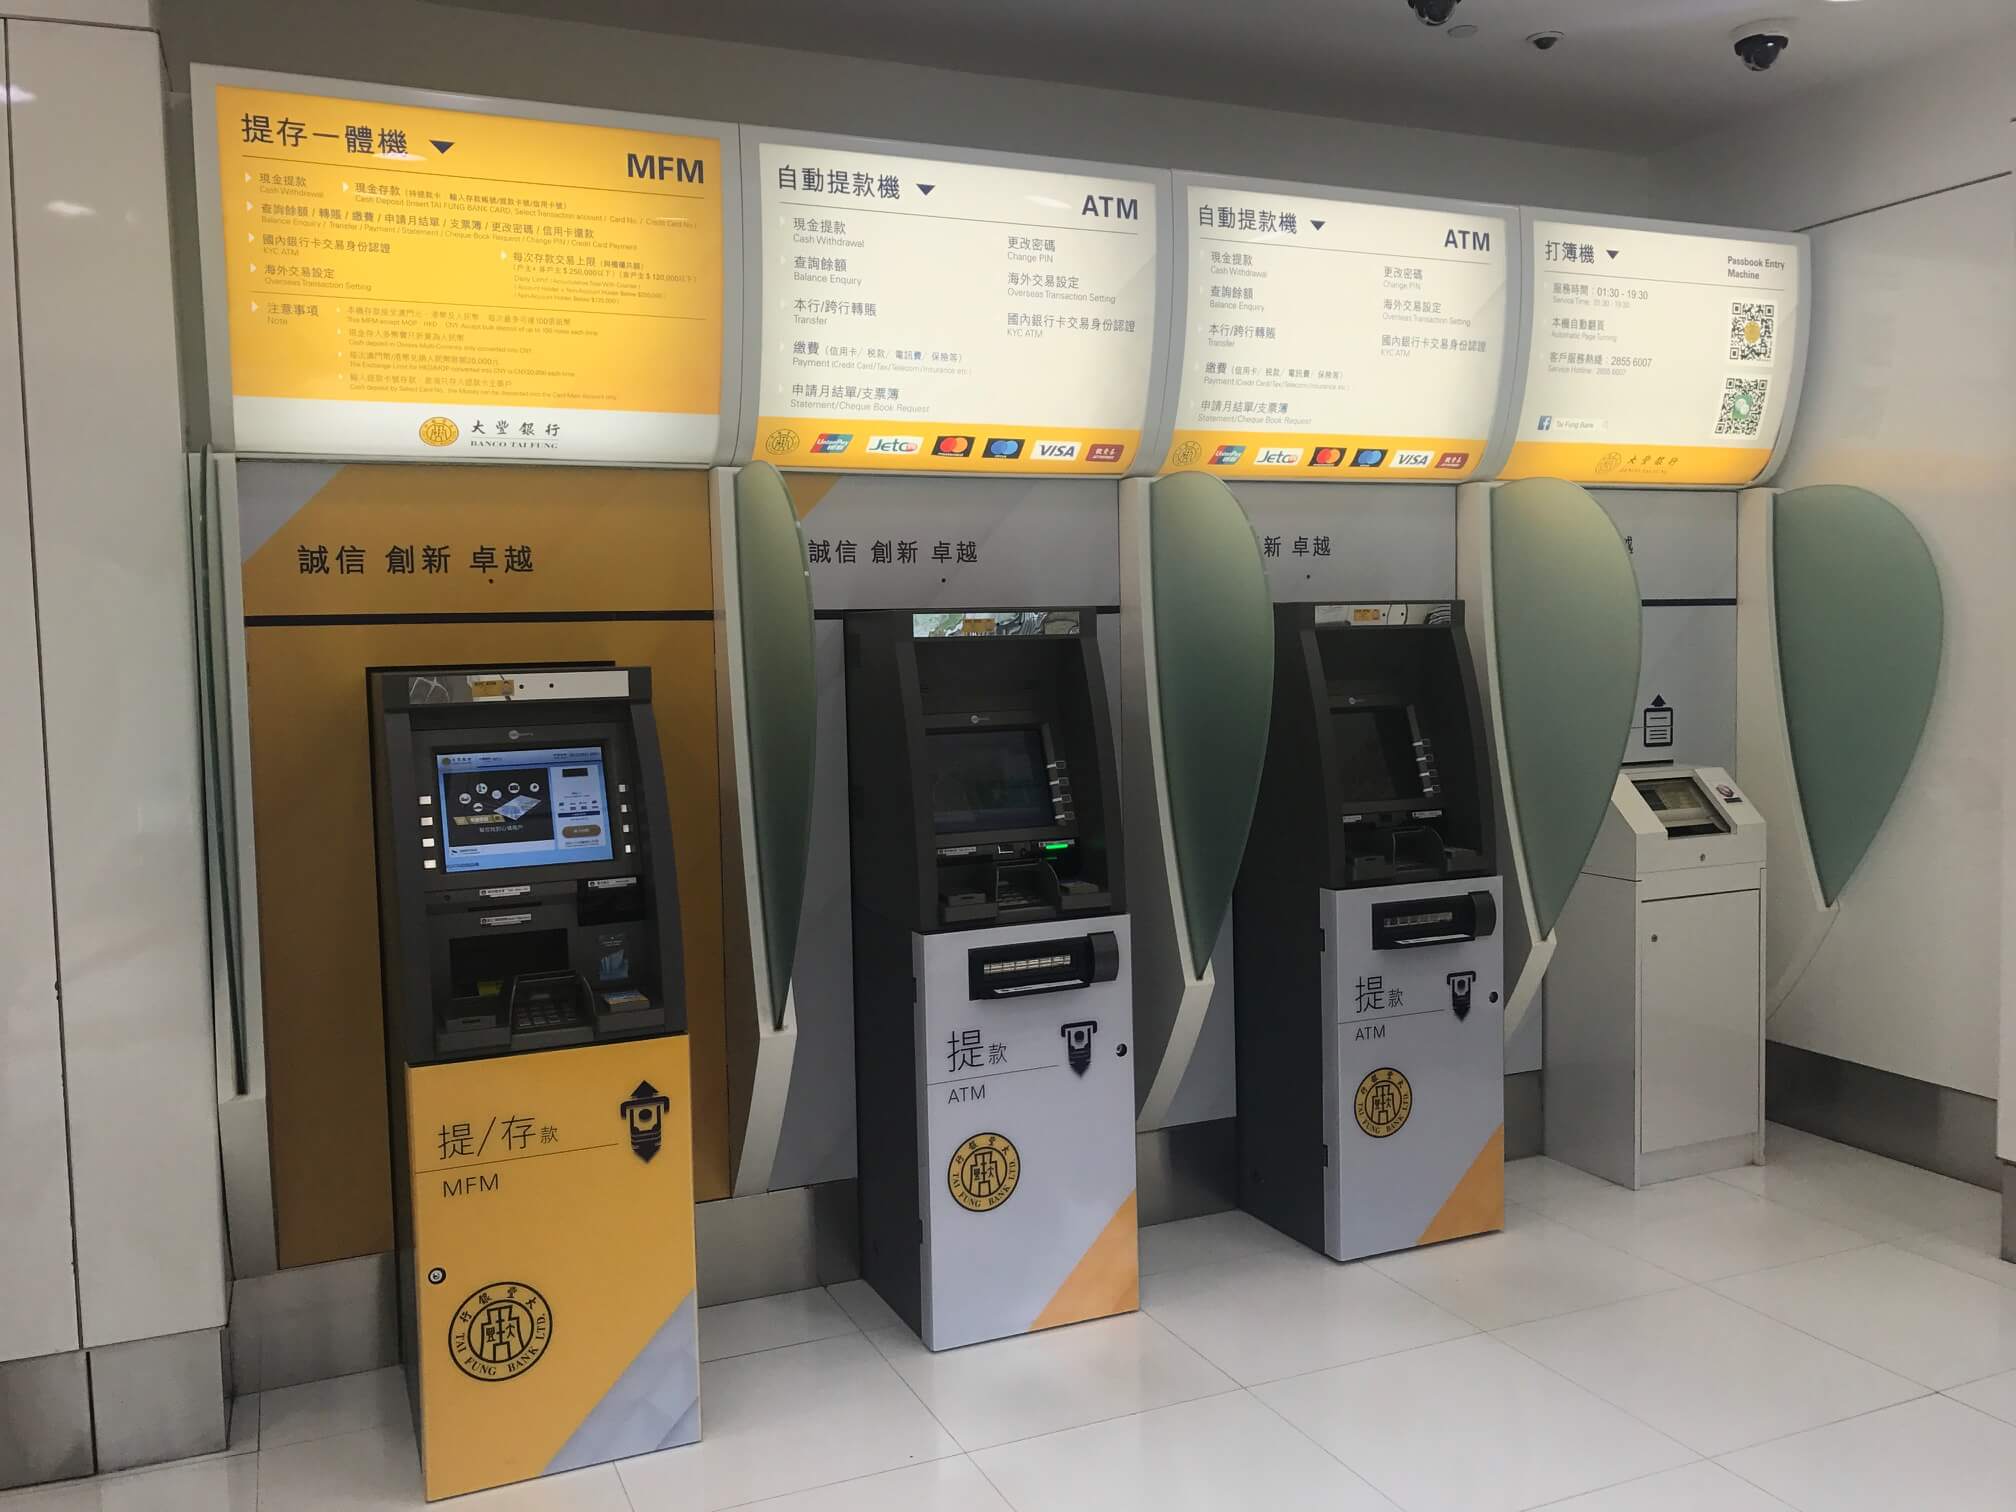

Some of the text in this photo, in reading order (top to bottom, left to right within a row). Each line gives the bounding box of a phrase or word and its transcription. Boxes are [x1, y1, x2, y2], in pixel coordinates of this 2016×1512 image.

[241, 112, 409, 155] 提存一體機
[627, 152, 705, 184] MFM
[259, 172, 307, 188] 現金提款
[778, 163, 900, 200] 自動提款機
[355, 182, 401, 198] 現金存款
[1081, 194, 1138, 220] ATM
[793, 217, 847, 235] 現金提款
[1199, 204, 1297, 235] 自動提款機
[793, 233, 865, 248] Cash Withdrawal
[1007, 236, 1056, 253] 更改密碼
[1444, 228, 1490, 252] ATM
[1007, 251, 1054, 264] Change PIN
[1210, 250, 1254, 267] 現金提款
[1544, 240, 1595, 265] 打簿機
[793, 255, 848, 273] 查詢餘額
[1727, 255, 1785, 271] Passbook Entry
[793, 271, 863, 287] Balance Enquiry
[1007, 271, 1080, 290] 海外交易設定
[1383, 265, 1423, 281] 更改密碼
[1727, 268, 1760, 280] Machine
[1007, 287, 1117, 305] Overseas Transaction Setting
[1210, 285, 1254, 301] 查詢餘額
[267, 302, 319, 318] 注意事項
[1383, 298, 1442, 315] 海外交易設定
[793, 314, 828, 326] Transfer
[1007, 312, 1136, 334] 國內銀行卡交易身份認證
[1006, 327, 1043, 339] KYC ATM
[792, 340, 820, 356] 繳費
[792, 356, 830, 370] Payment
[1610, 355, 1654, 369] 2855 6007
[792, 383, 901, 402] 申請月結單/支票簿
[872, 401, 895, 412] Book
[896, 403, 931, 415] Request
[470, 439, 507, 448] BANCO
[1039, 444, 1075, 458] VISA
[1397, 453, 1429, 466] VISA
[807, 539, 979, 564] 誠信 創新 卓越
[1260, 535, 1332, 558] 新 卓越
[297, 543, 535, 575] 誠信 創新 卓越
[1355, 975, 1404, 1013] 提款
[1355, 1024, 1386, 1041] ATM
[947, 1029, 1008, 1072] 提款
[947, 1084, 986, 1105] ATM
[442, 1172, 500, 1198] MFM
[952, 1172, 962, 1191] TAI
[958, 1190, 983, 1209] FUNG
[988, 1183, 1012, 1206] BANK
[454, 1311, 547, 1378] TAI FUNG BANK LTD.
